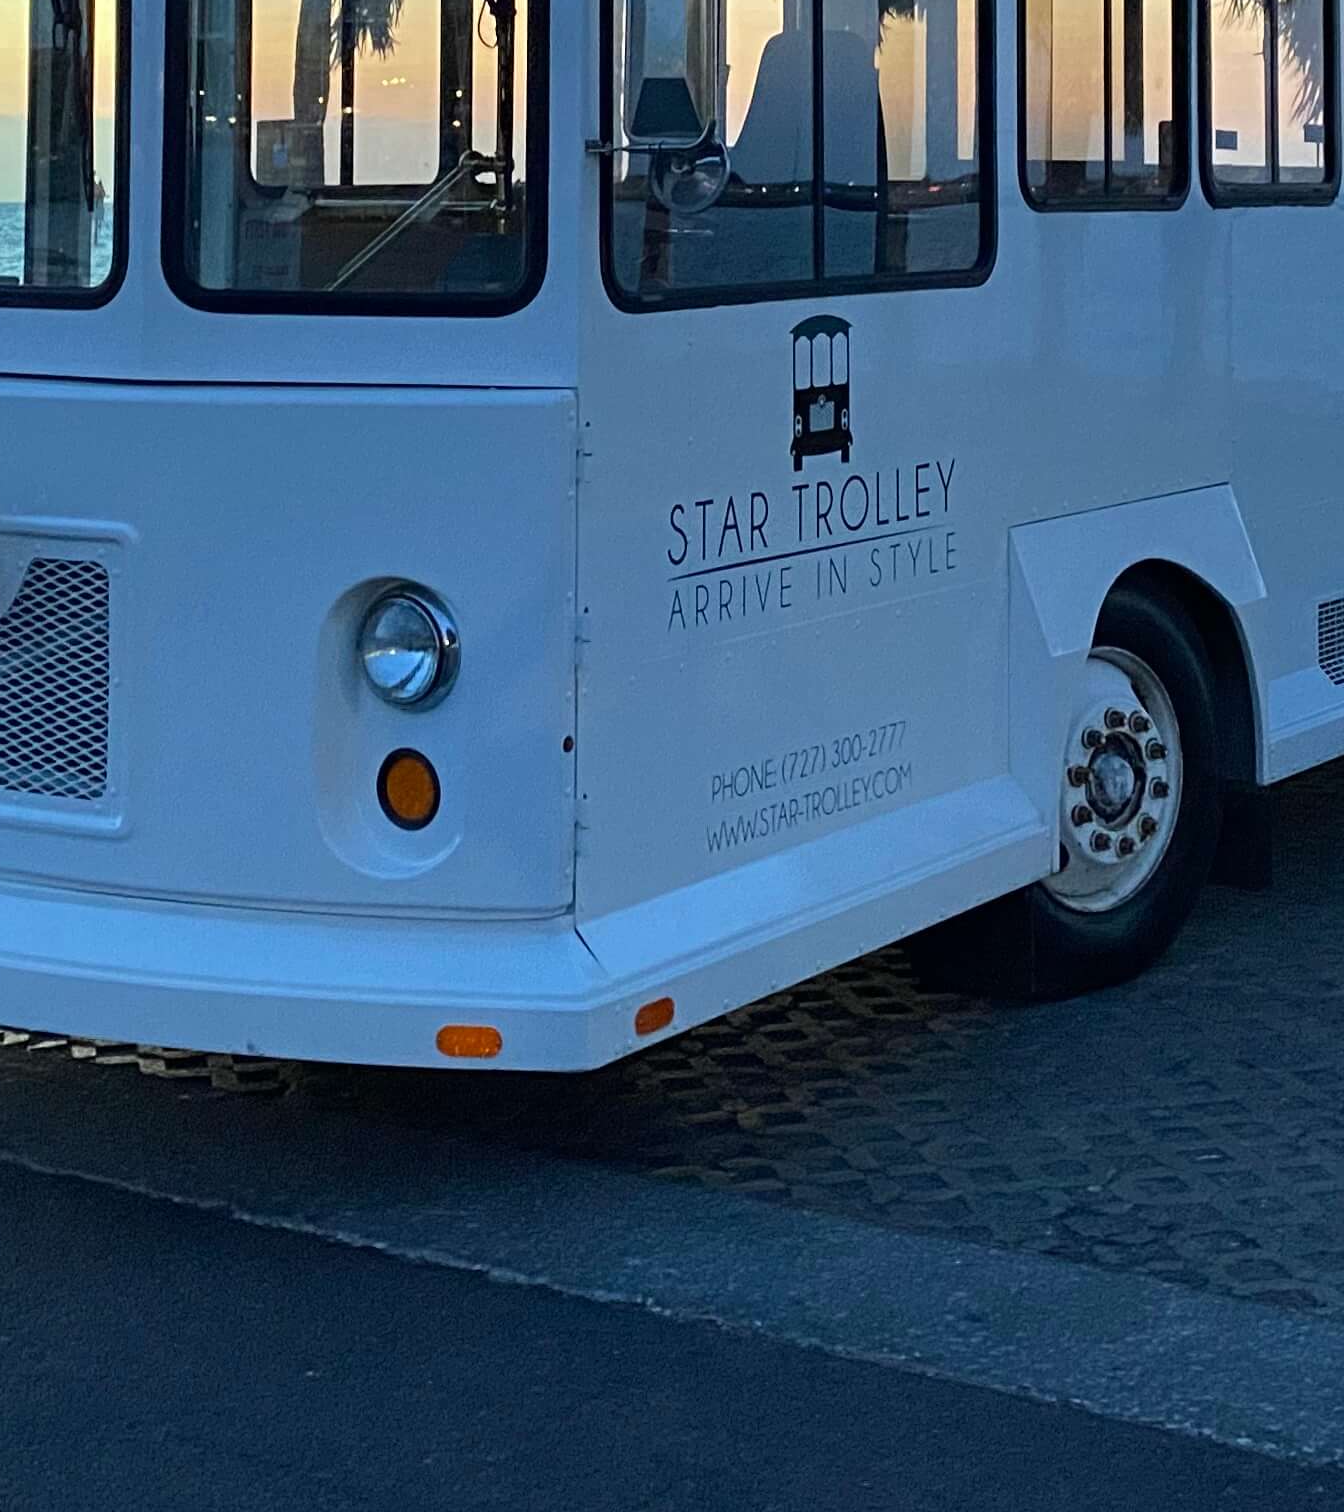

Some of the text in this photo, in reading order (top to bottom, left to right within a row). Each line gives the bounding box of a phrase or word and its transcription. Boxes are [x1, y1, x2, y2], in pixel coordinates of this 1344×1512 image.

[667, 458, 956, 566] STAR TROLLEY
[668, 531, 957, 633] ARRIVE IN STYLE
[781, 743, 827, 785] (727)
[831, 720, 907, 769] 300-2777
[706, 761, 913, 854] WWW.STAR-TROLLEY.COM
